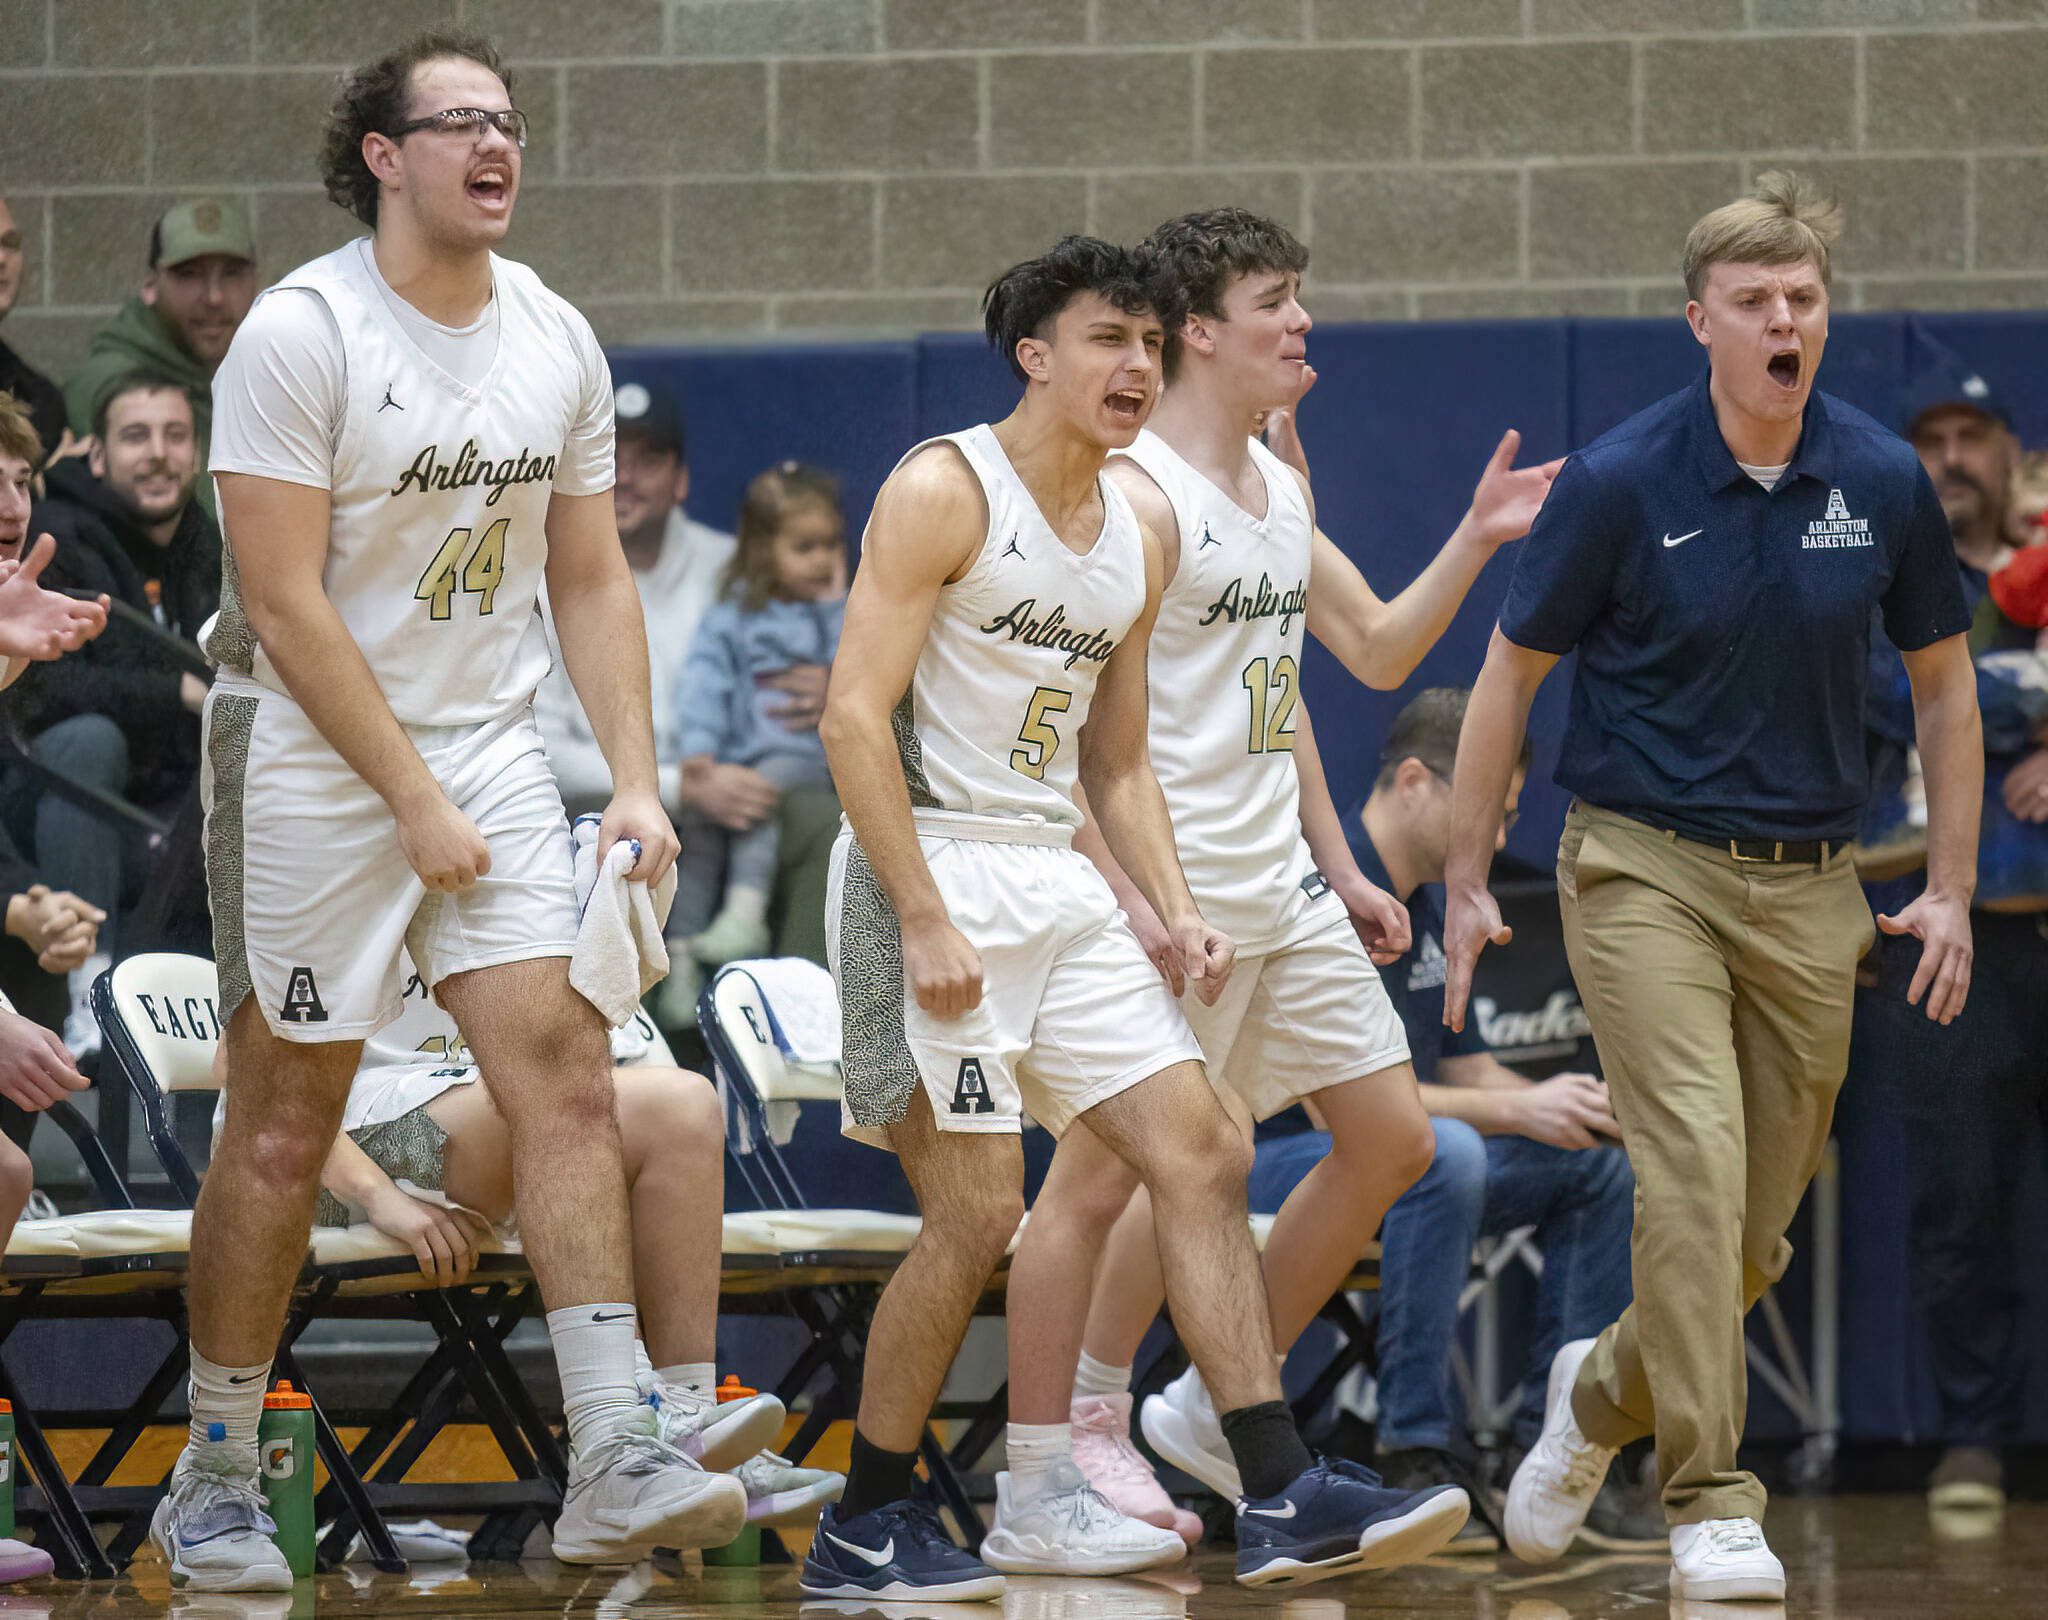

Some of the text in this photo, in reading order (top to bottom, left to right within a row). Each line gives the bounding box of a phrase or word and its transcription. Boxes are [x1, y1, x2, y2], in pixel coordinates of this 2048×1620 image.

[391, 439, 555, 507] Arlington
[1801, 533, 1874, 549] BASKETBALL
[1808, 519, 1869, 535] ARLINGTON
[414, 518, 511, 620] 44
[980, 599, 1114, 670] Arlingto
[1010, 686, 1073, 780] 5
[1242, 655, 1297, 754] 12
